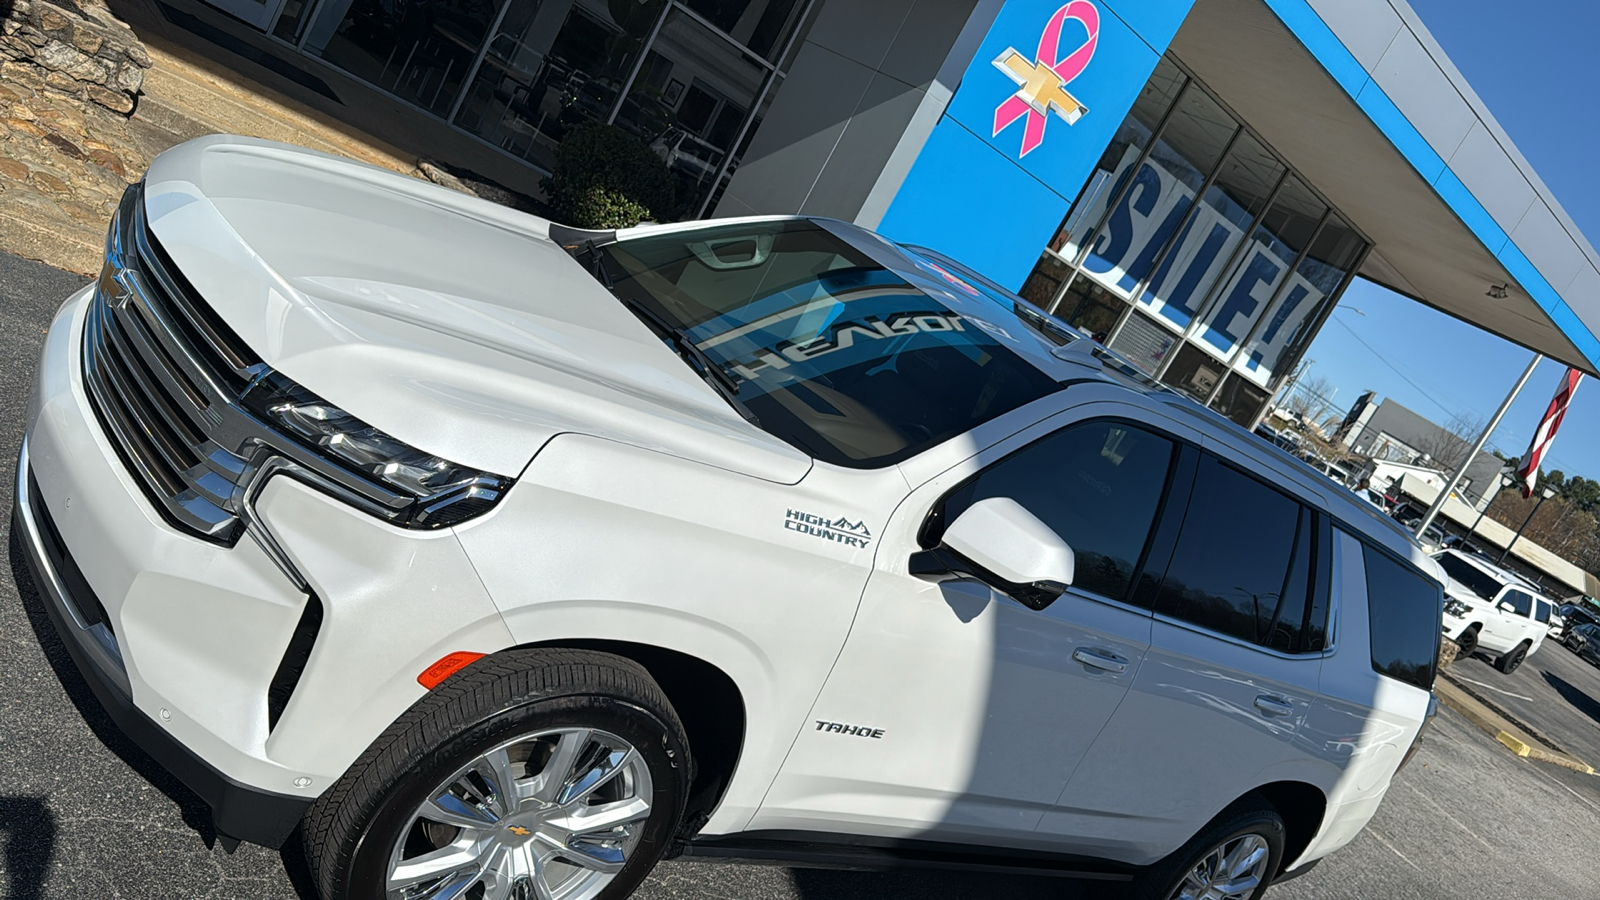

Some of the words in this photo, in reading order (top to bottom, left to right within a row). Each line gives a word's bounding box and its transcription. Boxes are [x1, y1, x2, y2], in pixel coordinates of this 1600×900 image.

[1077, 162, 1310, 373] SALE!
[786, 507, 831, 528] HIGH
[784, 519, 870, 549] COUNTRY
[815, 720, 886, 739] TAHOE
